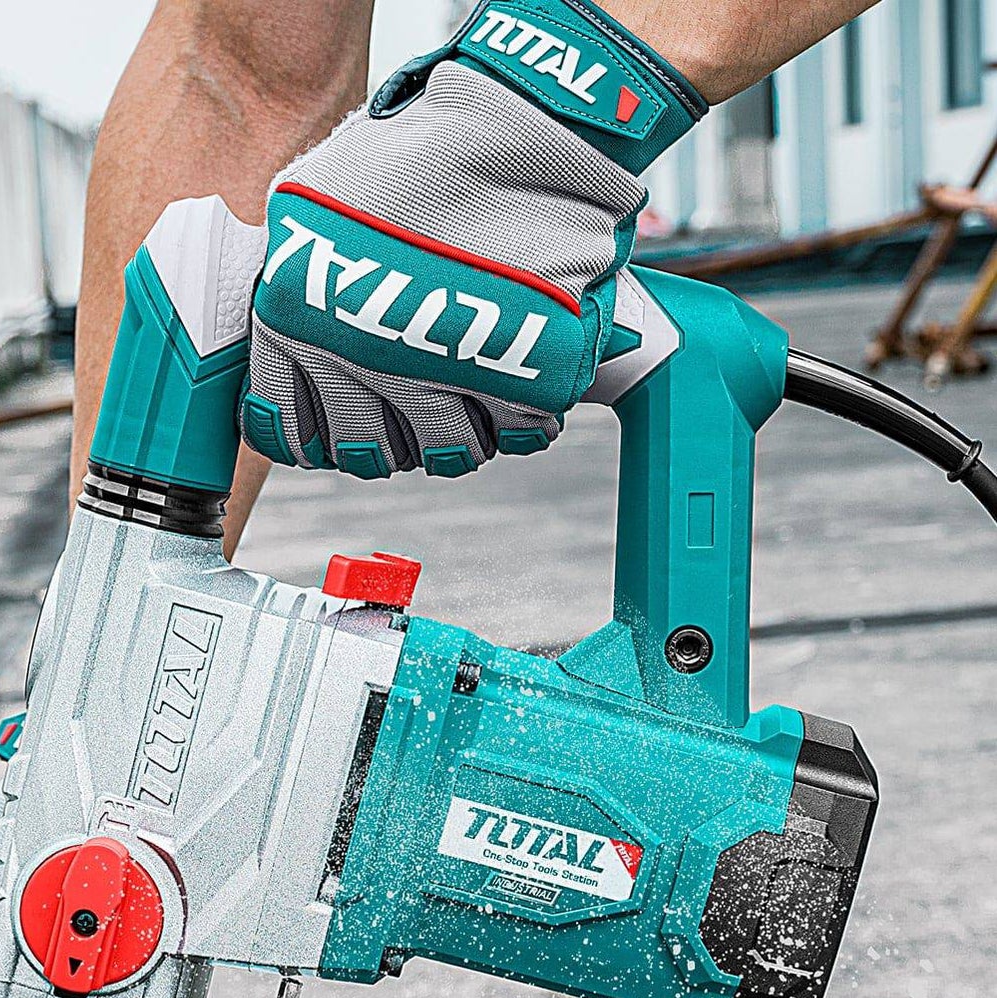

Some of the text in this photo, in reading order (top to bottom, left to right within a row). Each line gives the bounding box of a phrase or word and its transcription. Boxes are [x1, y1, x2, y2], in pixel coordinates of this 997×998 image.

[470, 10, 609, 104] TOTAL
[263, 215, 549, 380] TOTAL
[133, 615, 215, 807] TOTAL
[464, 806, 605, 874] TOTAL
[482, 848, 599, 887] One-Stop Tools Station
[492, 875, 553, 900] INDUSTRIAL
